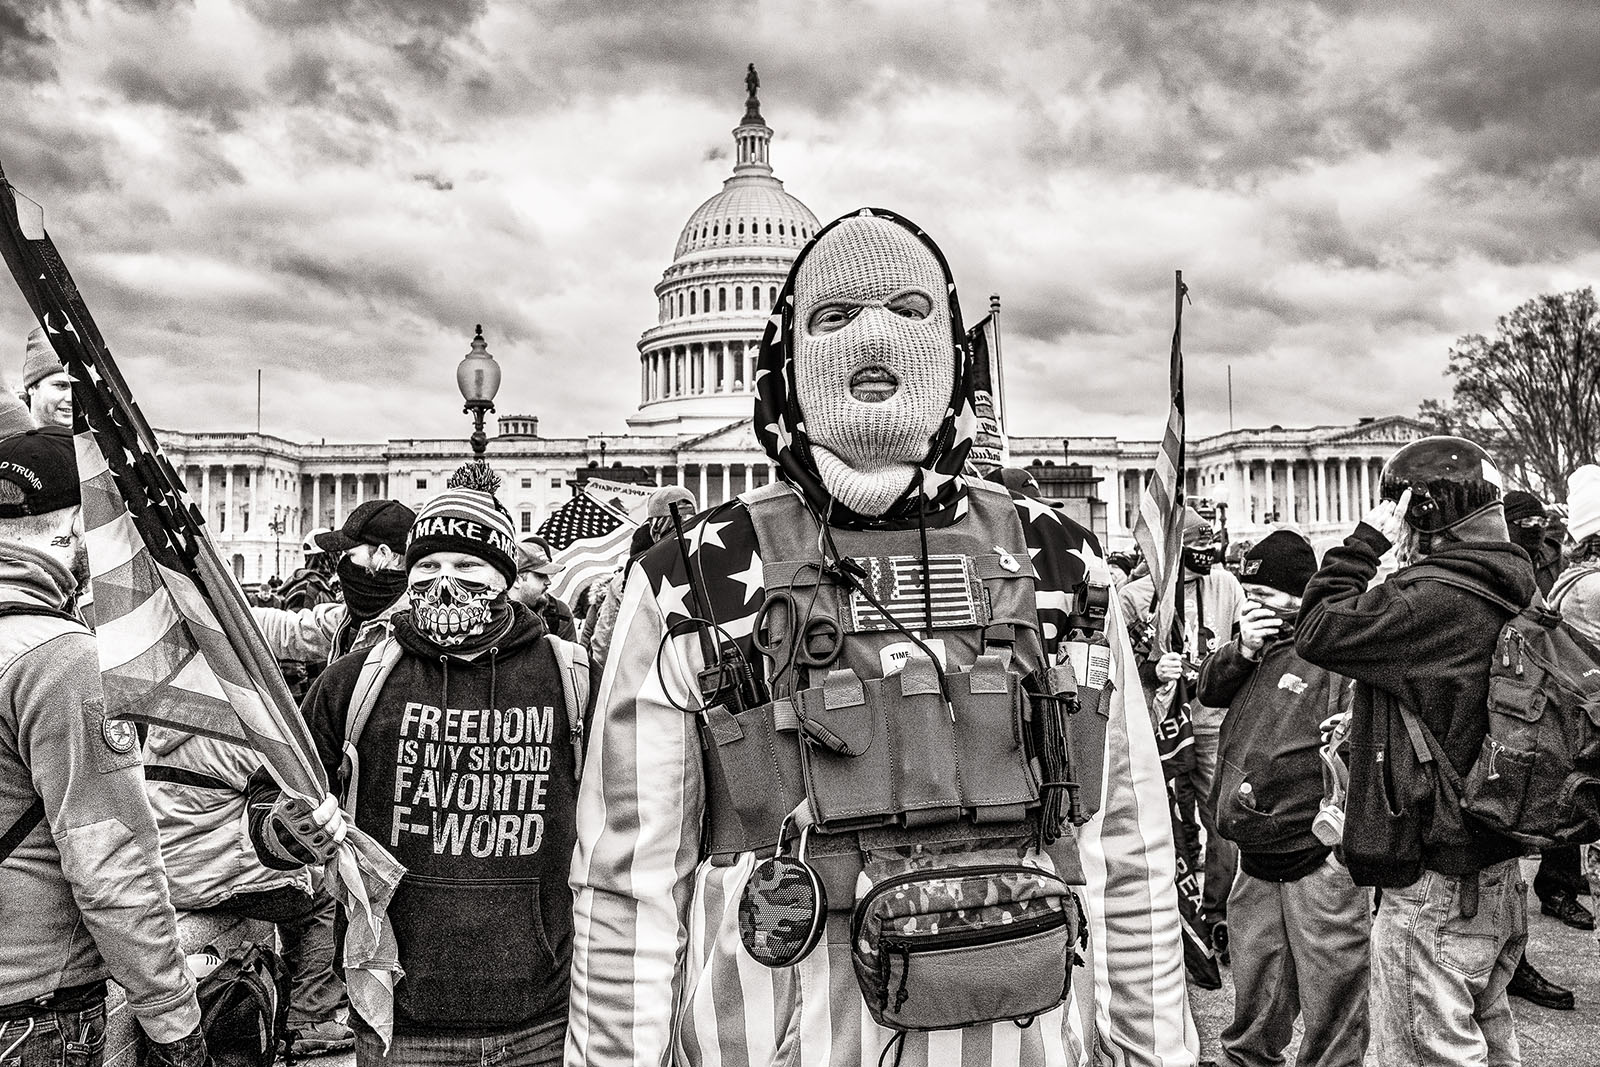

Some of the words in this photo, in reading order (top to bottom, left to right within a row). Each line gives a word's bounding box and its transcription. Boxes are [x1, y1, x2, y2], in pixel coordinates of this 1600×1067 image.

[11, 463, 43, 490] TRUMP
[415, 516, 482, 541] MAKE
[1192, 552, 1215, 561] TRU
[890, 650, 910, 661] TIME
[399, 701, 554, 744] FREEDOM
[397, 739, 419, 765] IS
[424, 742, 464, 770] MY
[468, 745, 552, 772] SECOND
[394, 765, 550, 812] FAVORITE
[390, 804, 545, 858] F-WORD
